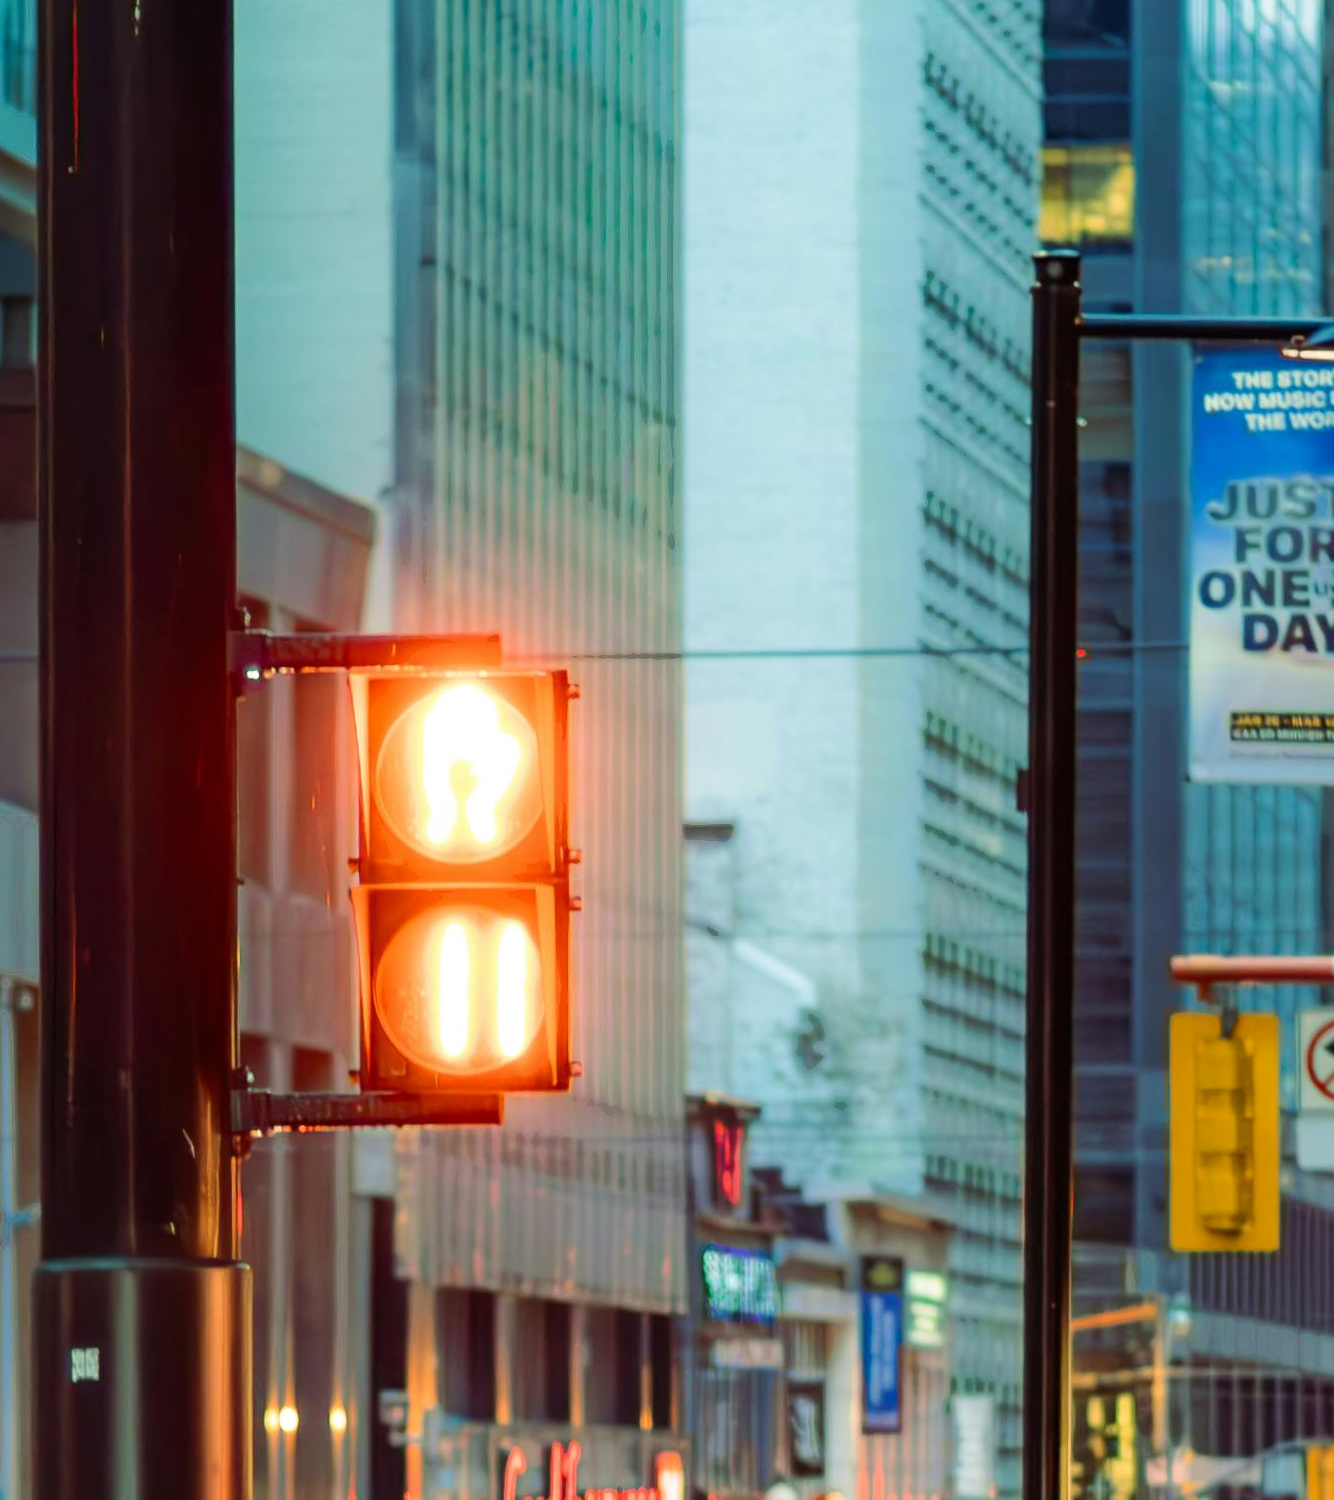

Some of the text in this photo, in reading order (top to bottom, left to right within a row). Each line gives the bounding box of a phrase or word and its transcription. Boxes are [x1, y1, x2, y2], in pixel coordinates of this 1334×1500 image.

[1233, 371, 1273, 389] THE
[1204, 392, 1256, 412] HOW
[1259, 390, 1326, 410] MUSIC
[1245, 413, 1286, 431] THE
[1198, 568, 1311, 608] ONE
